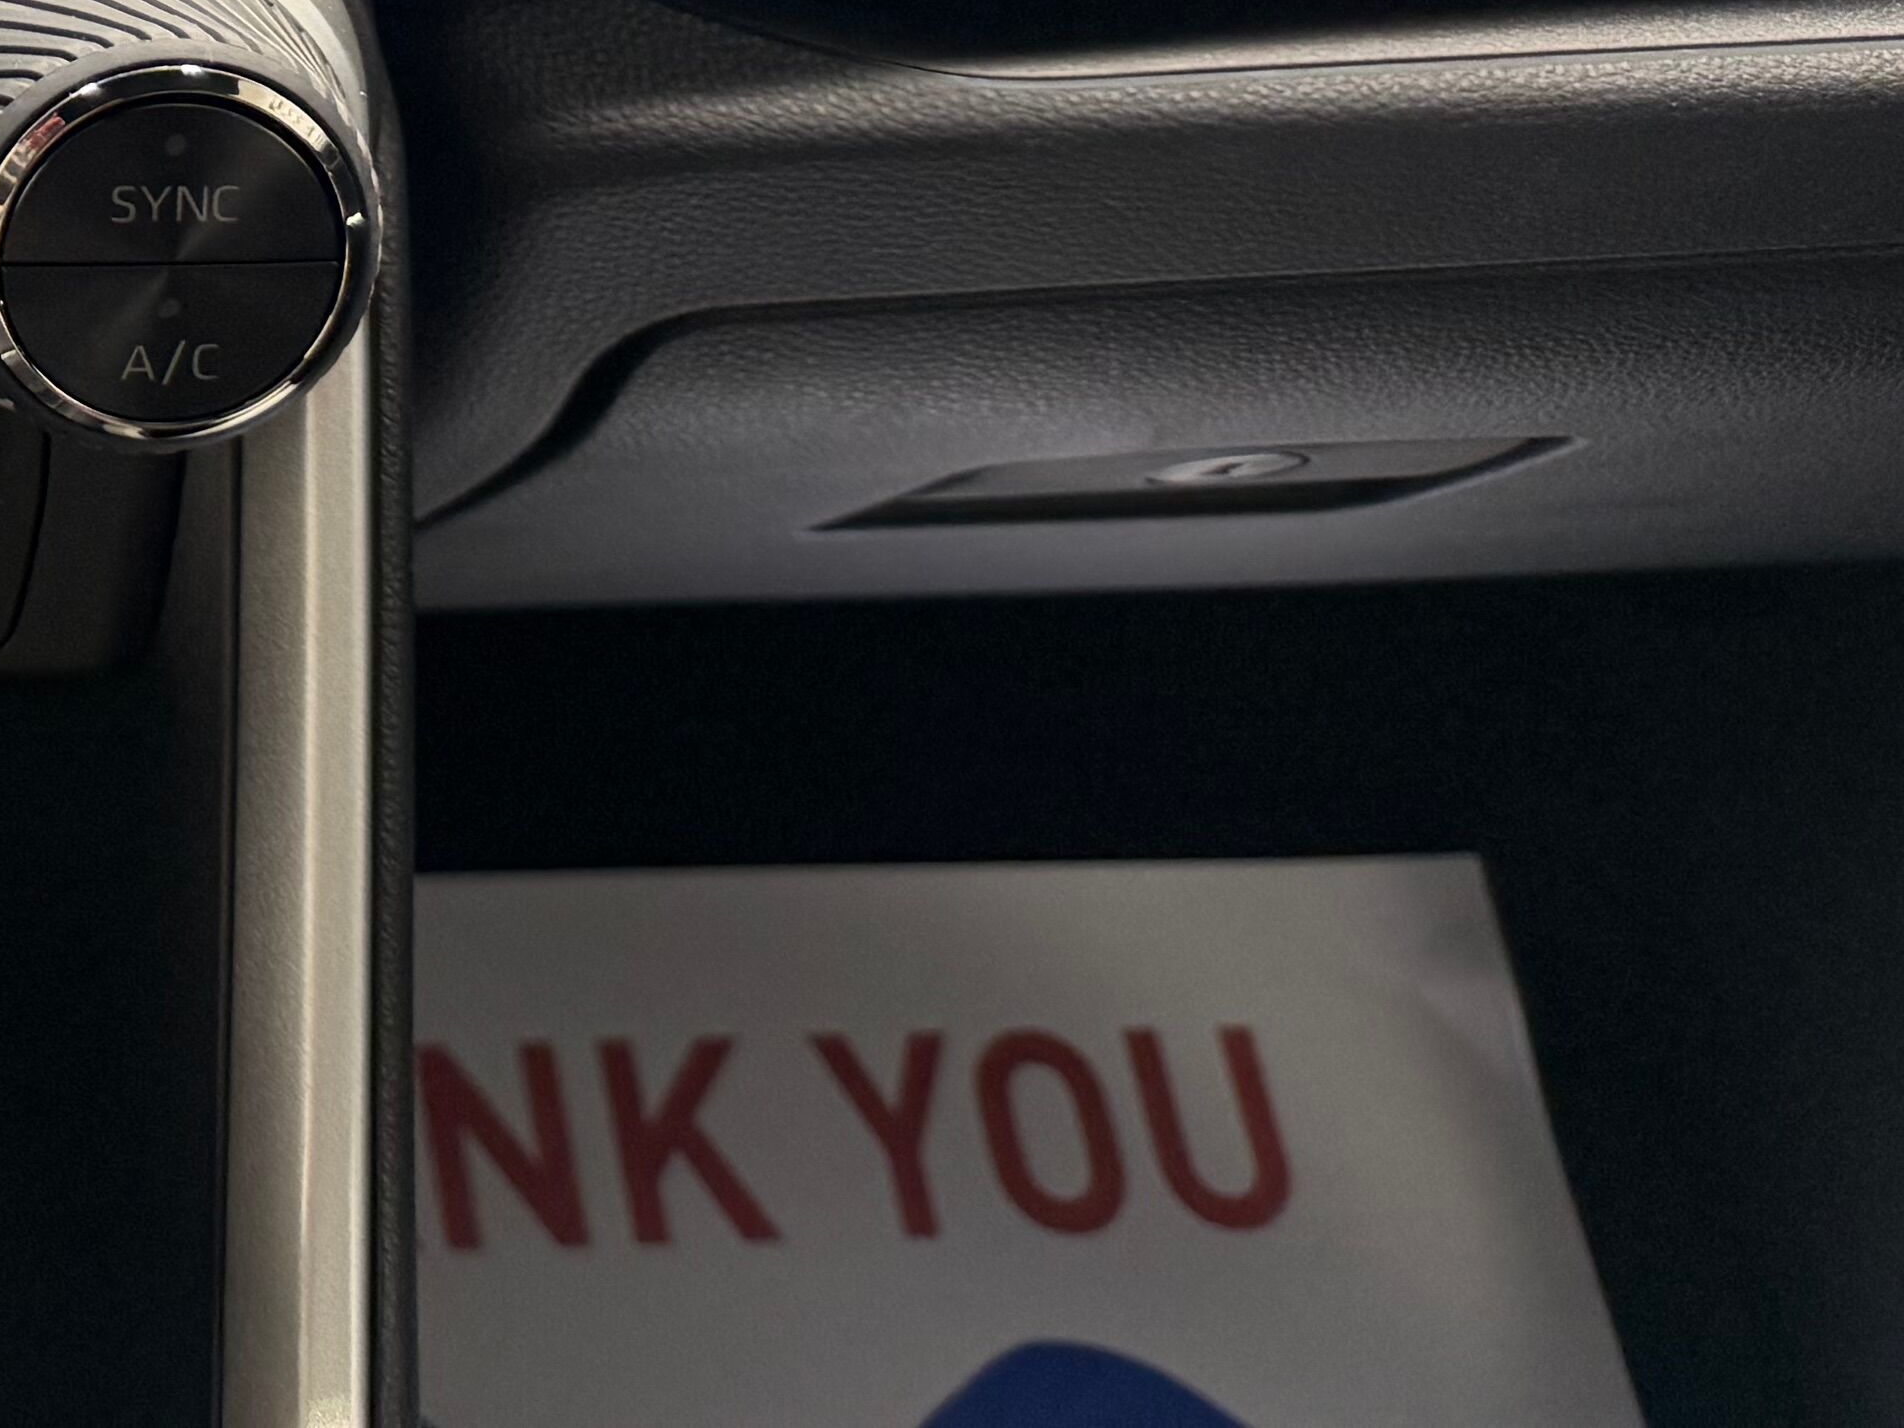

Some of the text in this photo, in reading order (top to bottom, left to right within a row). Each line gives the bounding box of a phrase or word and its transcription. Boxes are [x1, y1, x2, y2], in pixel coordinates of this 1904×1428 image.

[110, 184, 242, 223] SYNC
[120, 340, 220, 385] A/C
[414, 1022, 1294, 1254] NK YOU
